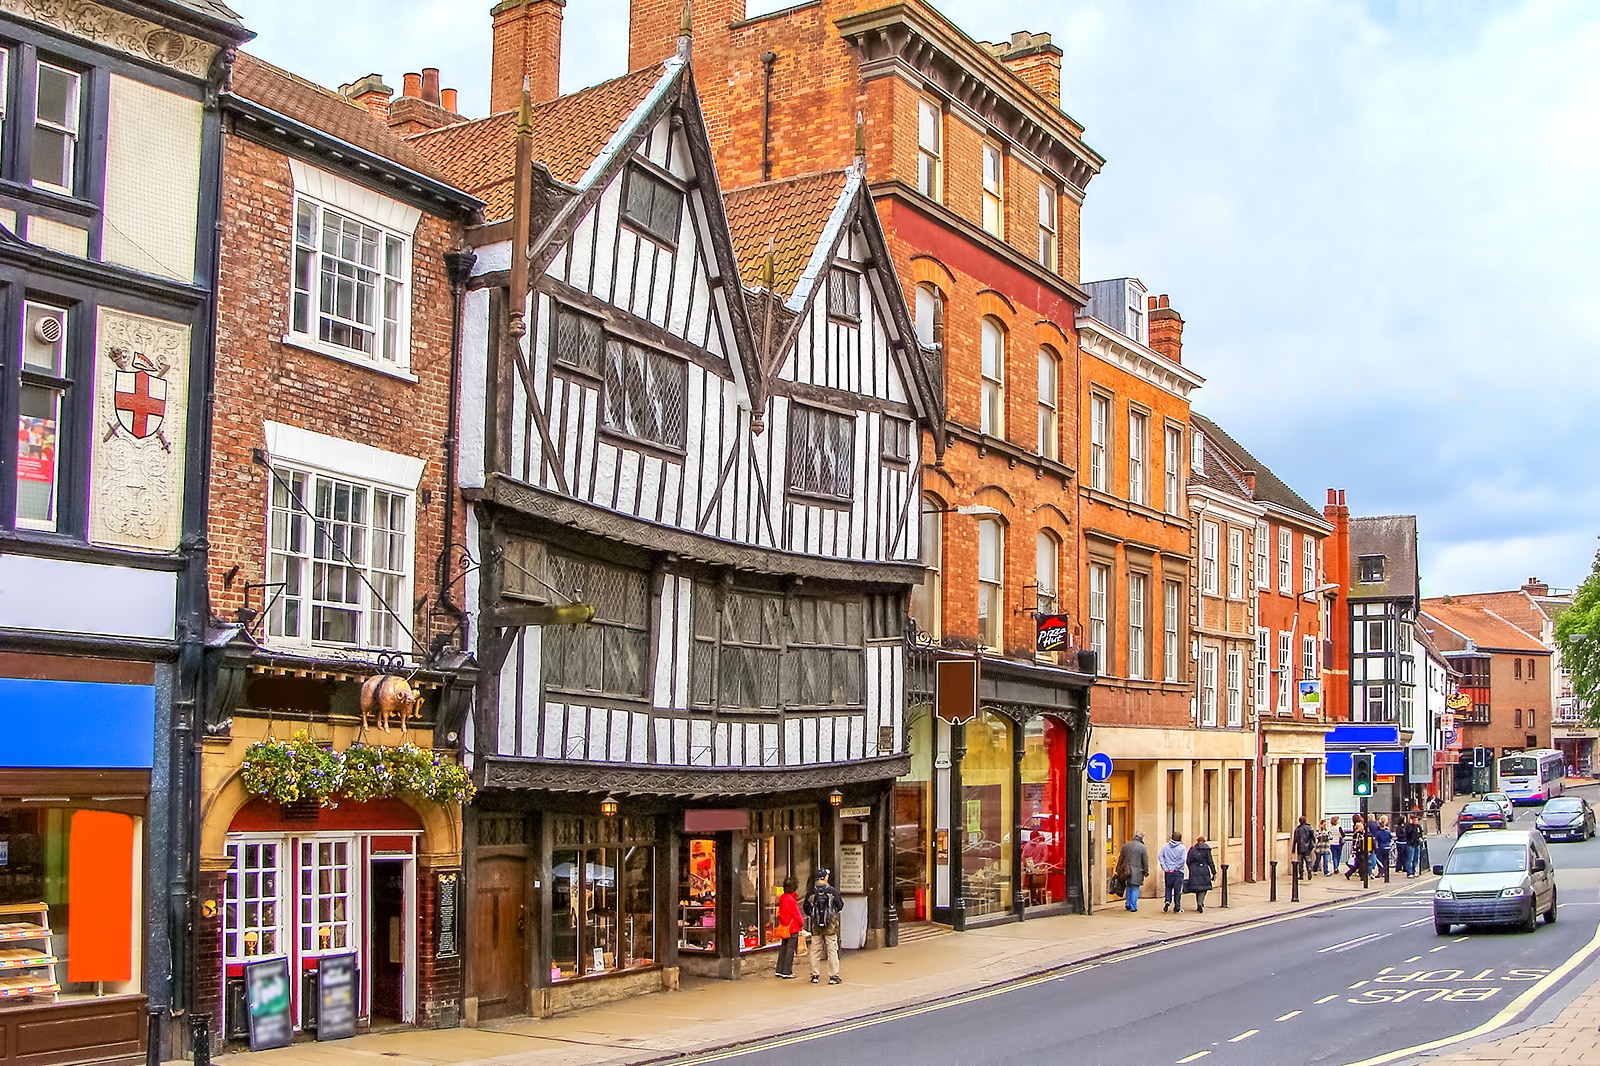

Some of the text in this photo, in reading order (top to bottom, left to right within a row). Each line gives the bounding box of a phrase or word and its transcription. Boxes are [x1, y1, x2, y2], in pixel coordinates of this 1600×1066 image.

[1038, 627, 1067, 644] Pizza
[1043, 635, 1064, 648] Hut
[1373, 968, 1551, 983] STOP
[1347, 987, 1502, 1004] BUS
